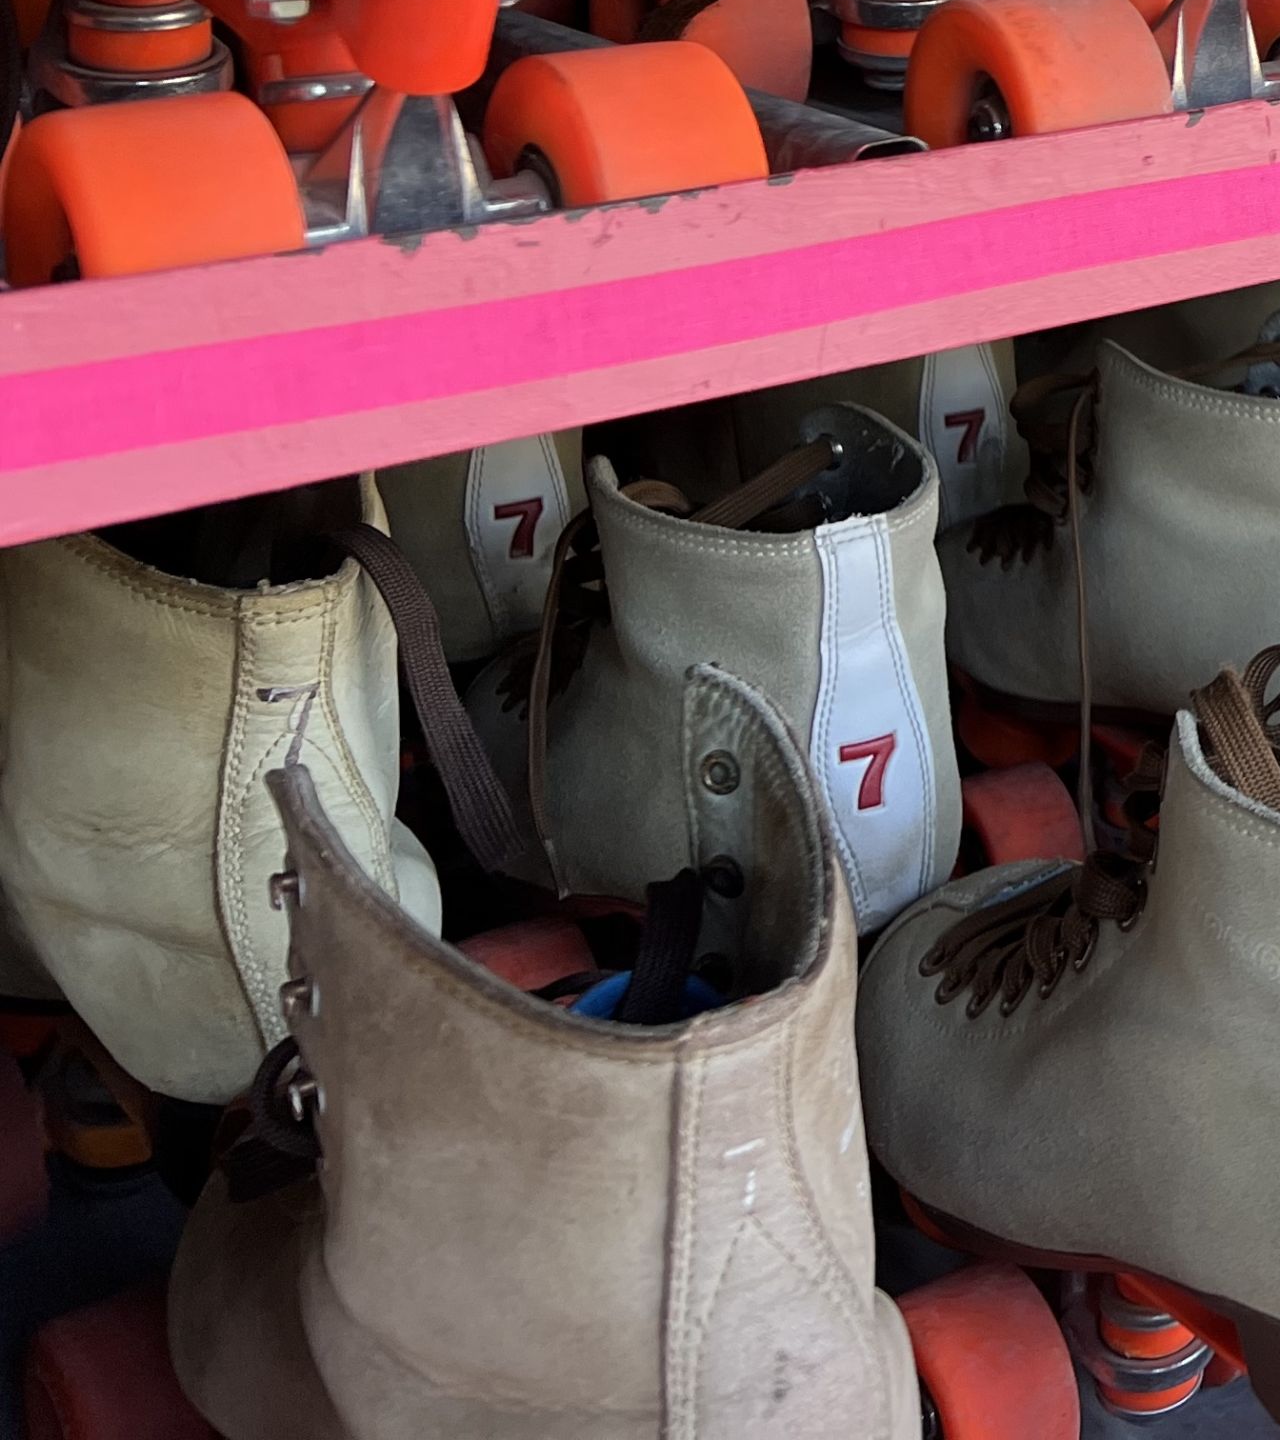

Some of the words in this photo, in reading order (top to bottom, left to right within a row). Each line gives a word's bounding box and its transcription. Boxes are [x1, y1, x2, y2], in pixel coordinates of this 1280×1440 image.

[945, 410, 984, 463] 7
[494, 496, 543, 559] 7
[840, 733, 895, 811] 7
